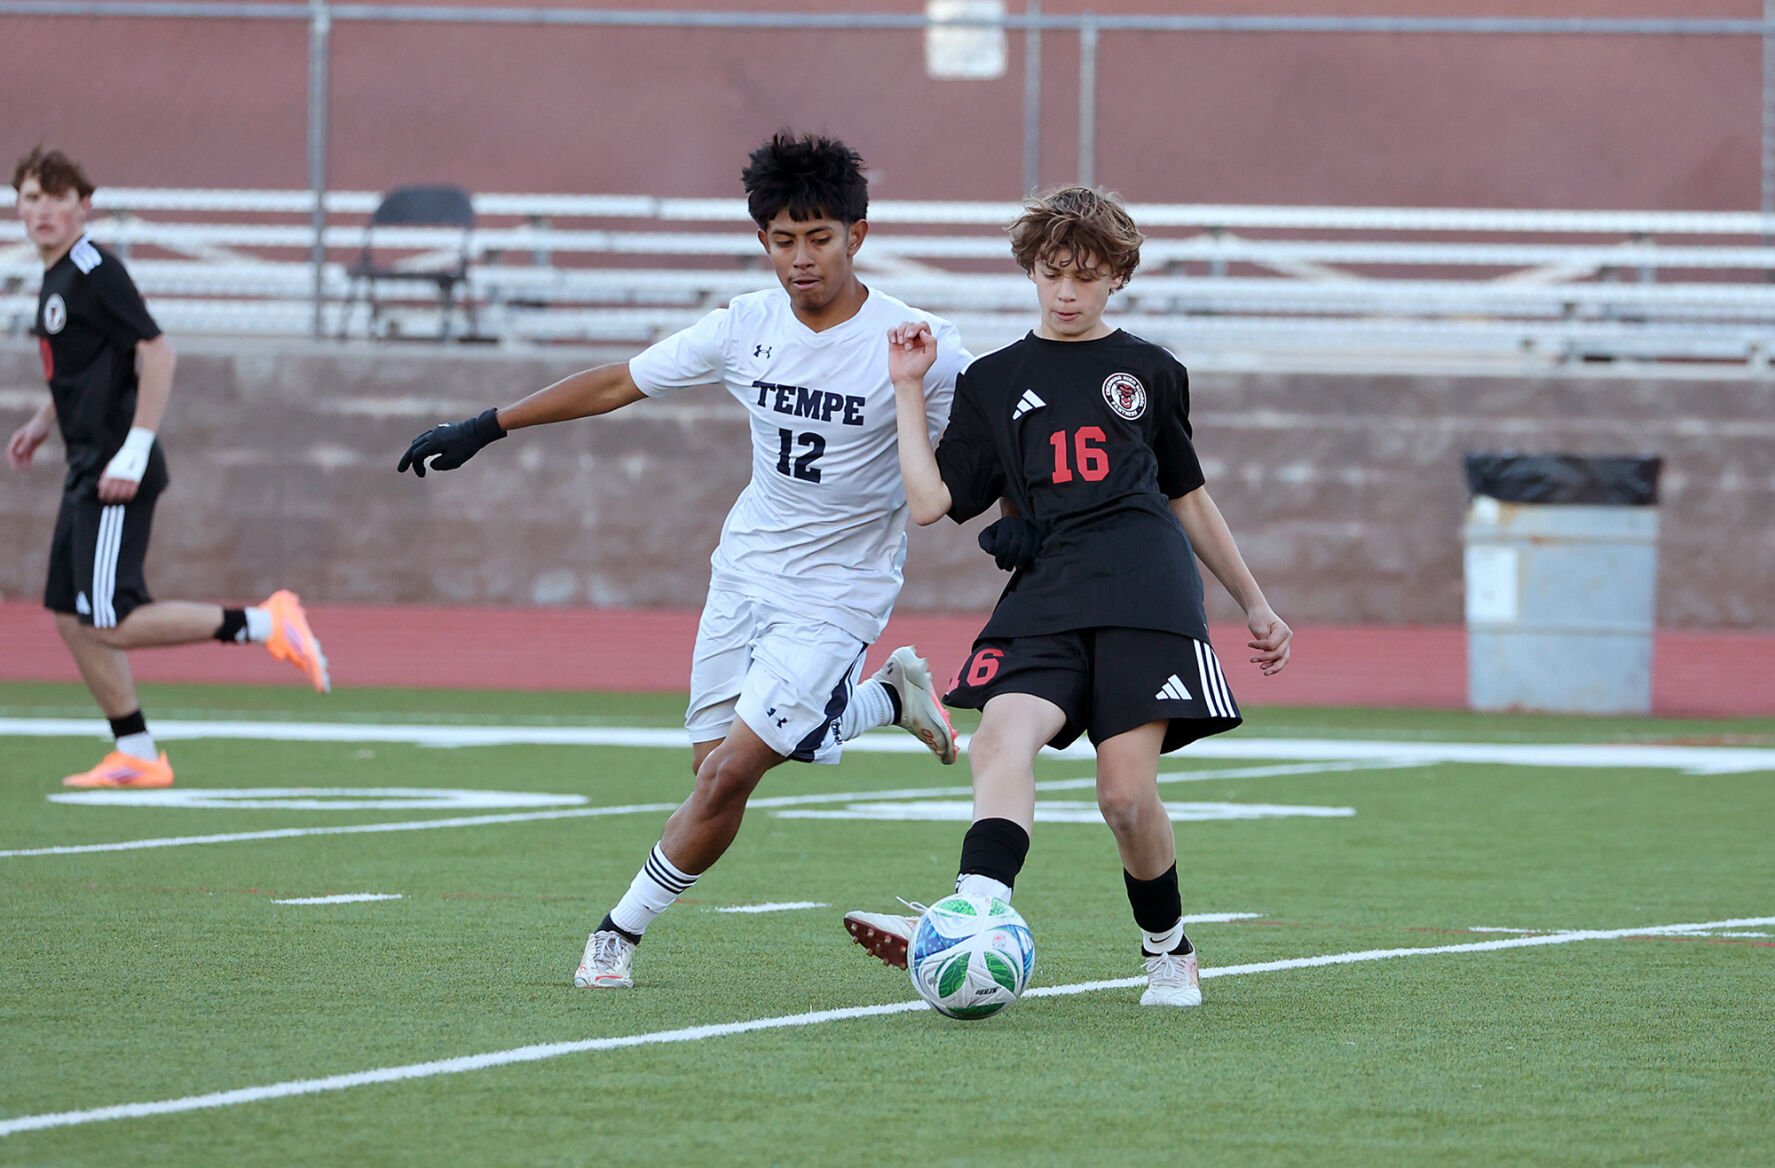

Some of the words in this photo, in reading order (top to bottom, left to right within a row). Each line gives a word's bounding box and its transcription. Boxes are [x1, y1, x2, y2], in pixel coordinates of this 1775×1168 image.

[752, 380, 866, 426] TEMPE
[776, 428, 827, 484] 12
[1050, 426, 1110, 484] 16
[949, 648, 1005, 692] 6
